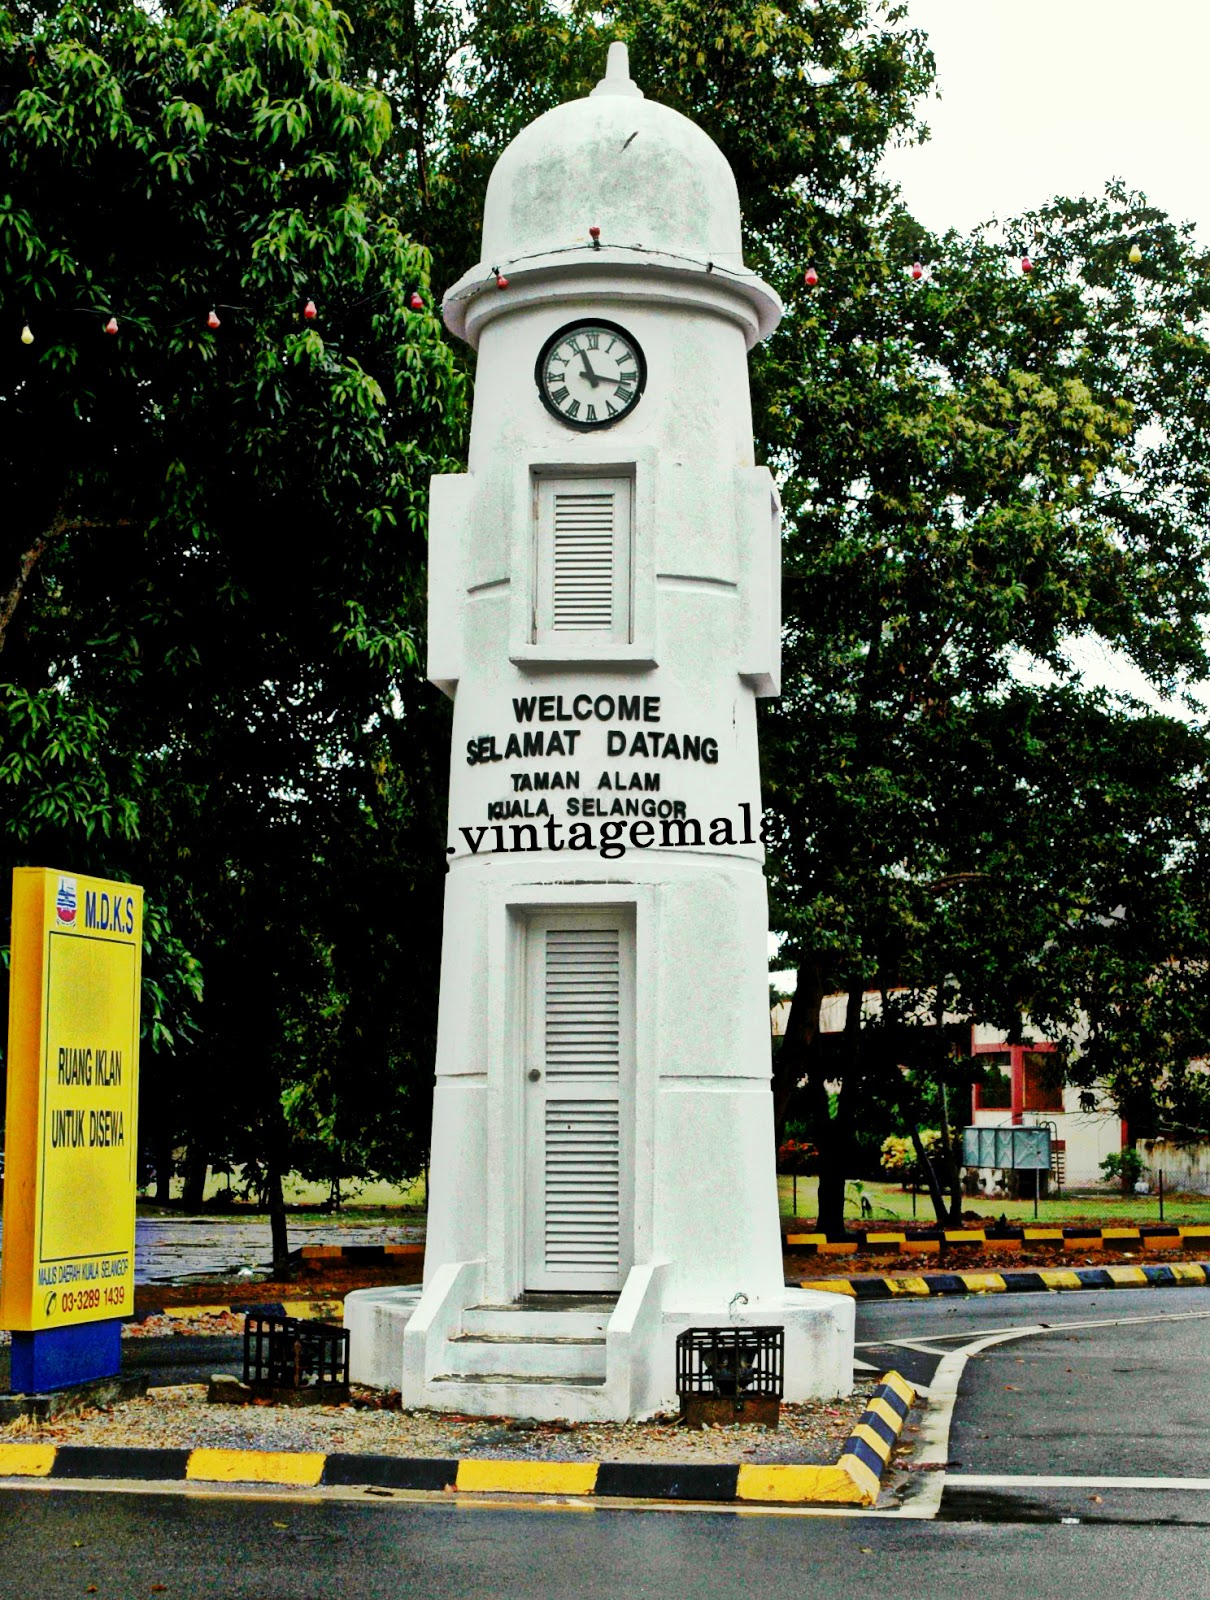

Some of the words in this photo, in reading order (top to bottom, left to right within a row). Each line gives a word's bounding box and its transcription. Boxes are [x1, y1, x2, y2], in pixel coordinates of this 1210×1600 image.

[512, 694, 661, 723] WELCOME
[466, 729, 581, 765] SELAMAT
[607, 730, 719, 764] DATANG
[511, 771, 580, 792] TAMAN
[598, 771, 660, 792] ALAM
[487, 799, 549, 821] KUALA
[566, 797, 687, 820] SELANGOR
[85, 891, 134, 935] M.D.K.S
[58, 1047, 92, 1086] RUANG
[95, 1049, 121, 1087] IKLAN
[52, 1109, 85, 1148] UNTUK
[89, 1109, 124, 1147] DISEWA
[82, 1262, 99, 1281] KUALA
[101, 1258, 128, 1278] SELANGOR
[61, 1288, 100, 1312] 03-3289
[103, 1286, 125, 1306] 1439
